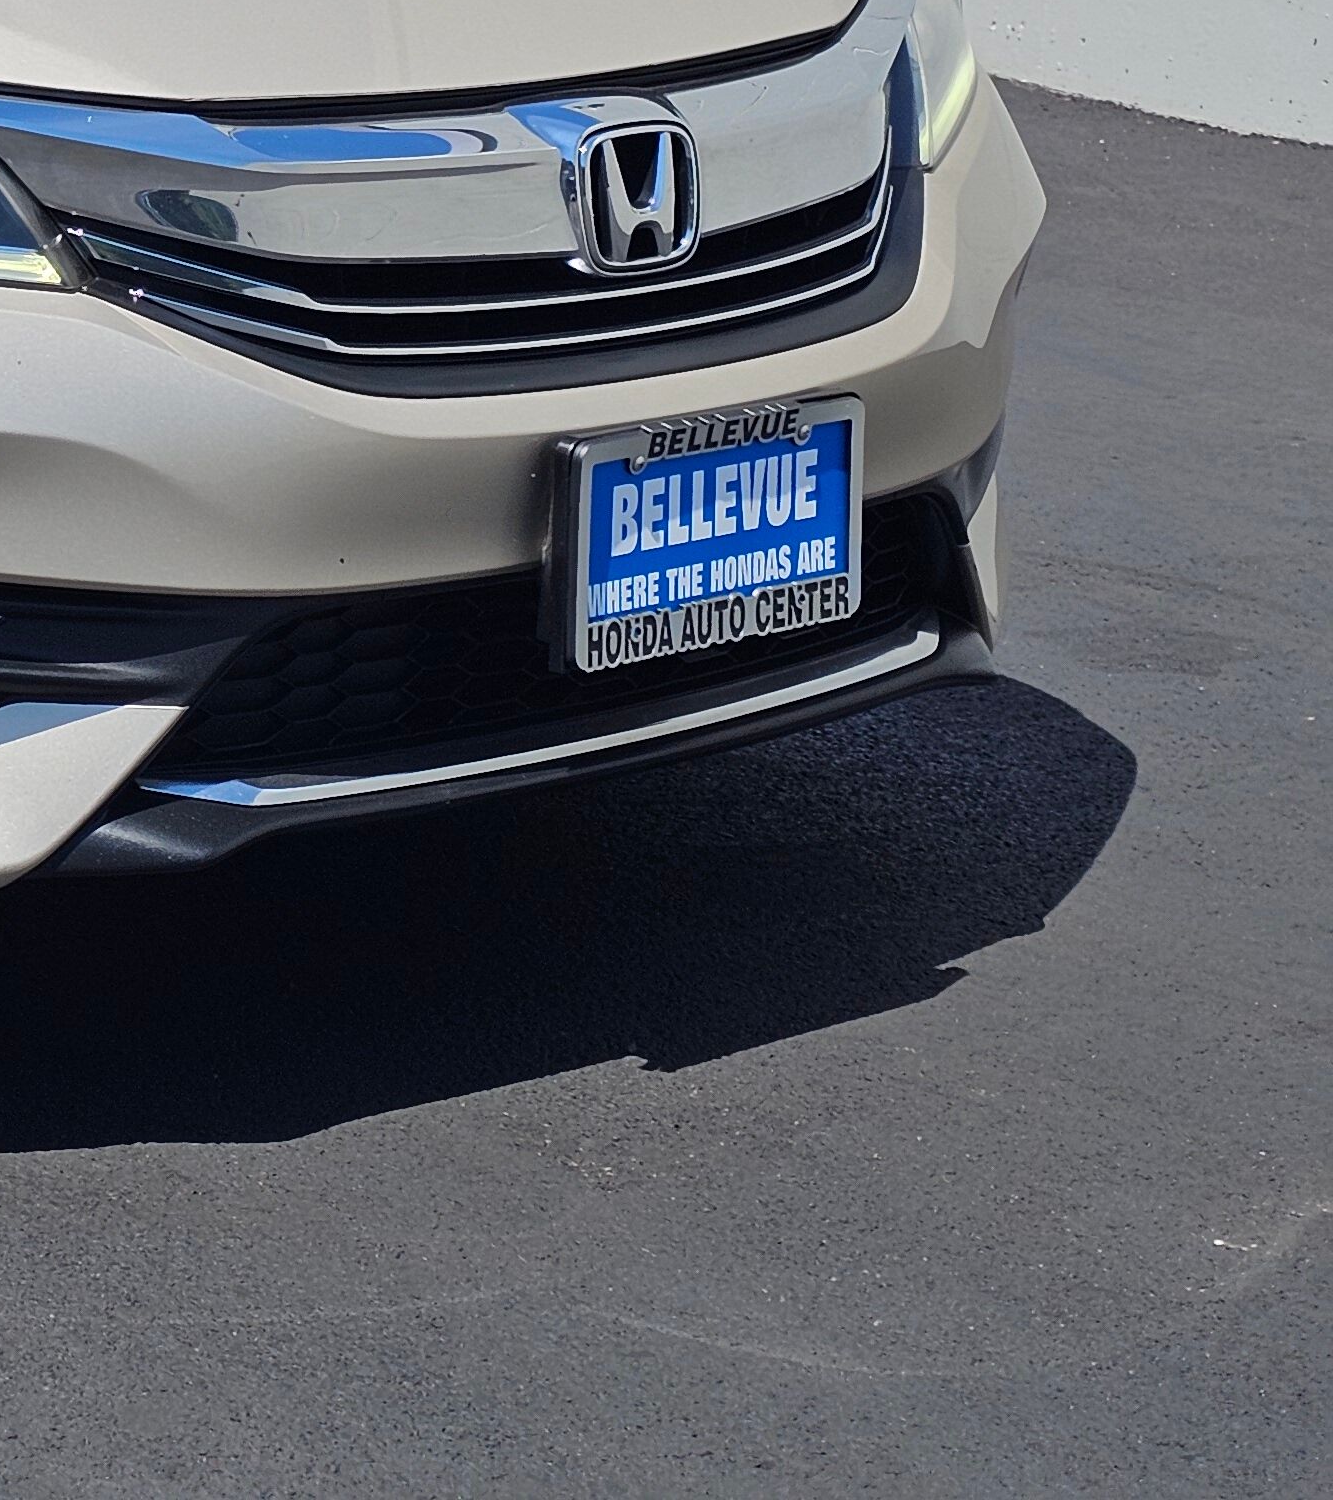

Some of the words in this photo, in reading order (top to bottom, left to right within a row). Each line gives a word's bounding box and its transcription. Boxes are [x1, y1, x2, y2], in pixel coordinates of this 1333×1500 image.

[648, 409, 800, 458] BELLEVUE
[610, 449, 819, 557] BELLEVUE
[588, 571, 660, 618] WHERE
[666, 562, 704, 602] THE
[710, 545, 792, 593] HONDAS
[797, 536, 836, 576] ARE
[587, 610, 674, 669] HONDA
[680, 595, 745, 649] AUTO
[755, 576, 849, 633] CENTER
